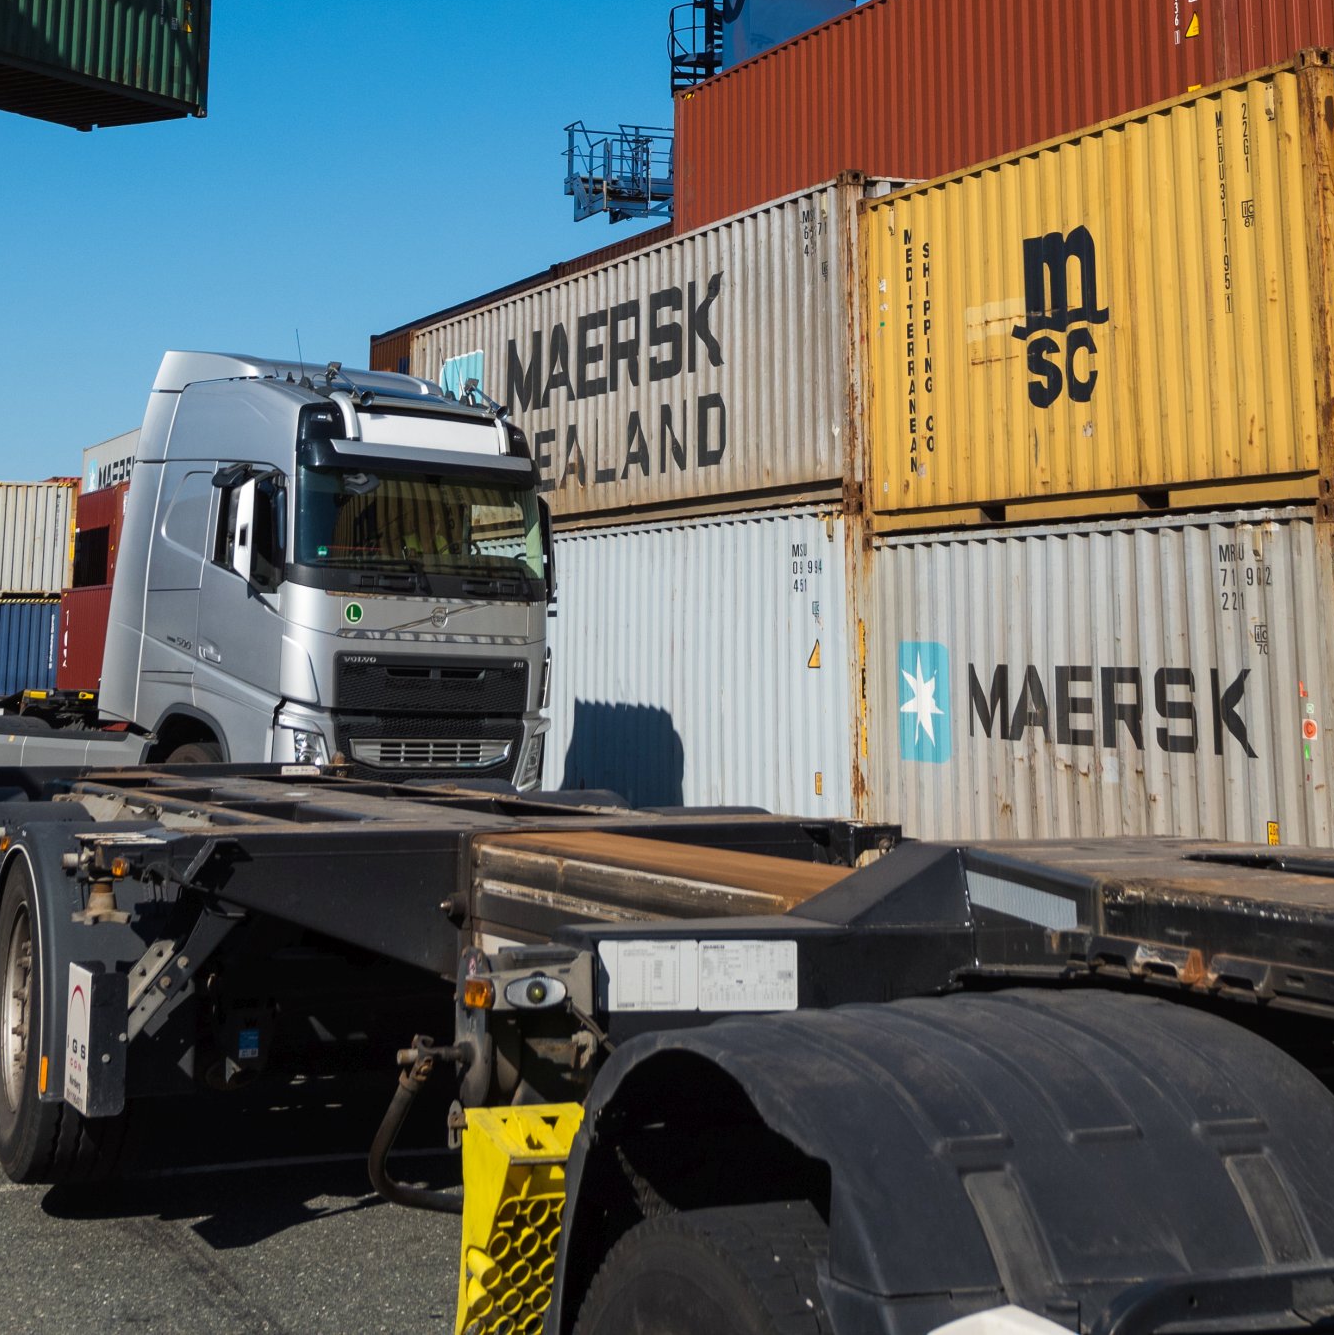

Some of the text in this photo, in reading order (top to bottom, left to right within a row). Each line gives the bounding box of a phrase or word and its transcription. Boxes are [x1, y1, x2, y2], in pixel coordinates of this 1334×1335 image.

[1241, 102, 1249, 174] 22G1
[506, 270, 723, 414] MAERSK
[903, 228, 917, 472] MEDITERRANEAN
[922, 242, 934, 452] SHIPPING CO
[535, 392, 726, 494] EALAND
[969, 663, 1259, 759] MAERSK
